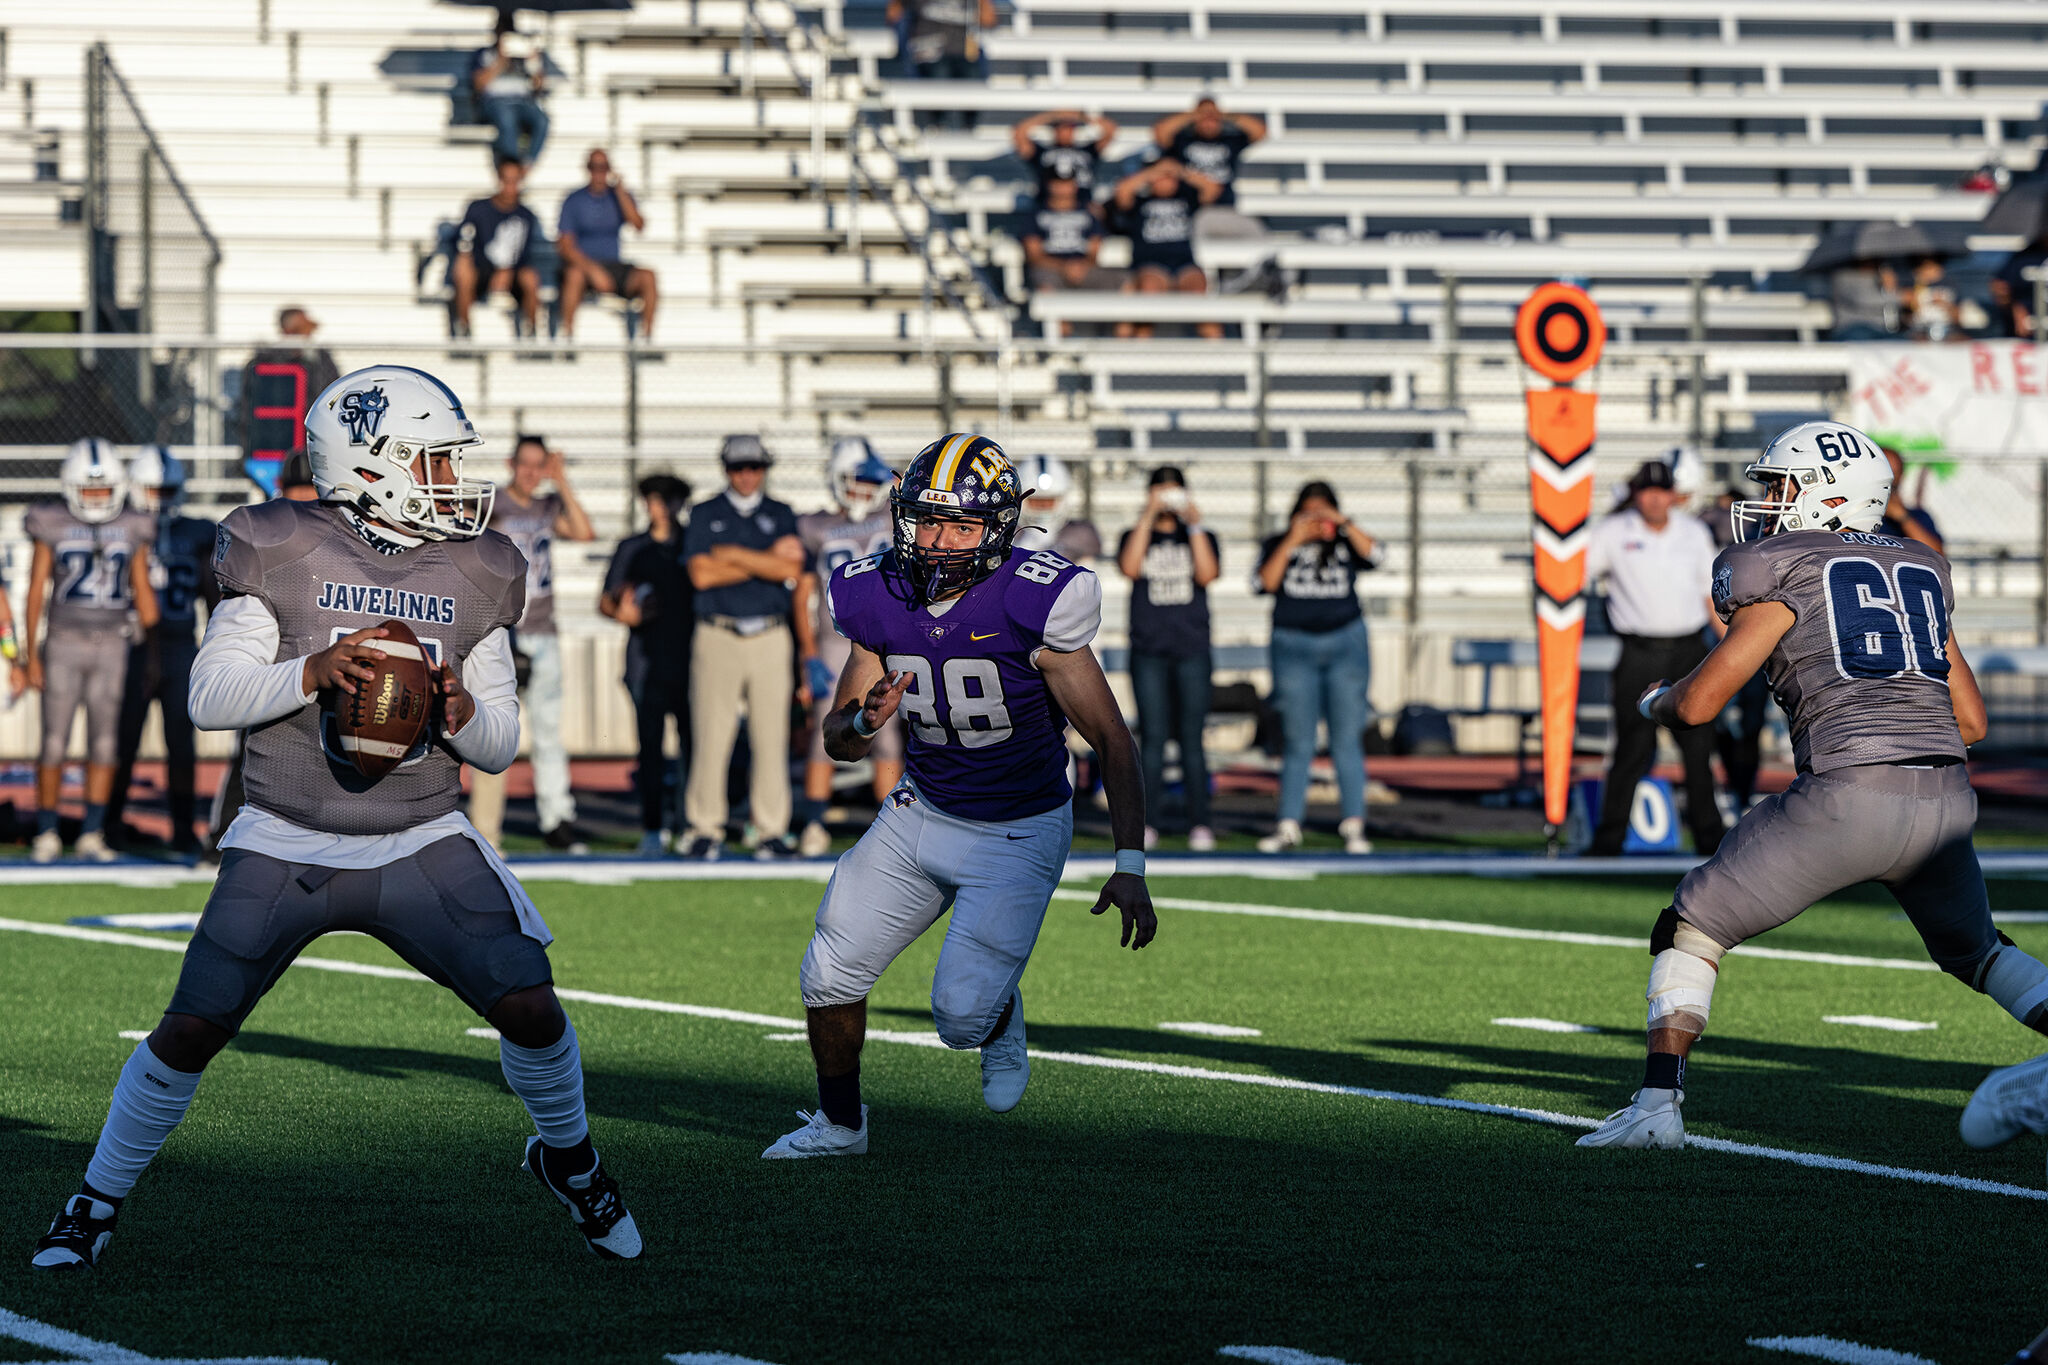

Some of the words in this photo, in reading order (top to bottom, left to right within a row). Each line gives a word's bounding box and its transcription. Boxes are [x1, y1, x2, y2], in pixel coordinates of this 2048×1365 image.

[254, 363, 307, 461] 3
[1852, 355, 1931, 424] THE
[1968, 341, 2048, 397] RE
[1816, 431, 1862, 462] 60
[926, 492, 949, 504] L.E.O.
[55, 540, 132, 610] 21
[1015, 551, 1073, 585] 88
[317, 581, 455, 625] JAVELINAS
[1823, 556, 1950, 690] 60
[373, 673, 394, 725] Wilson
[886, 655, 1013, 749] 88
[1630, 780, 1669, 844] 0
